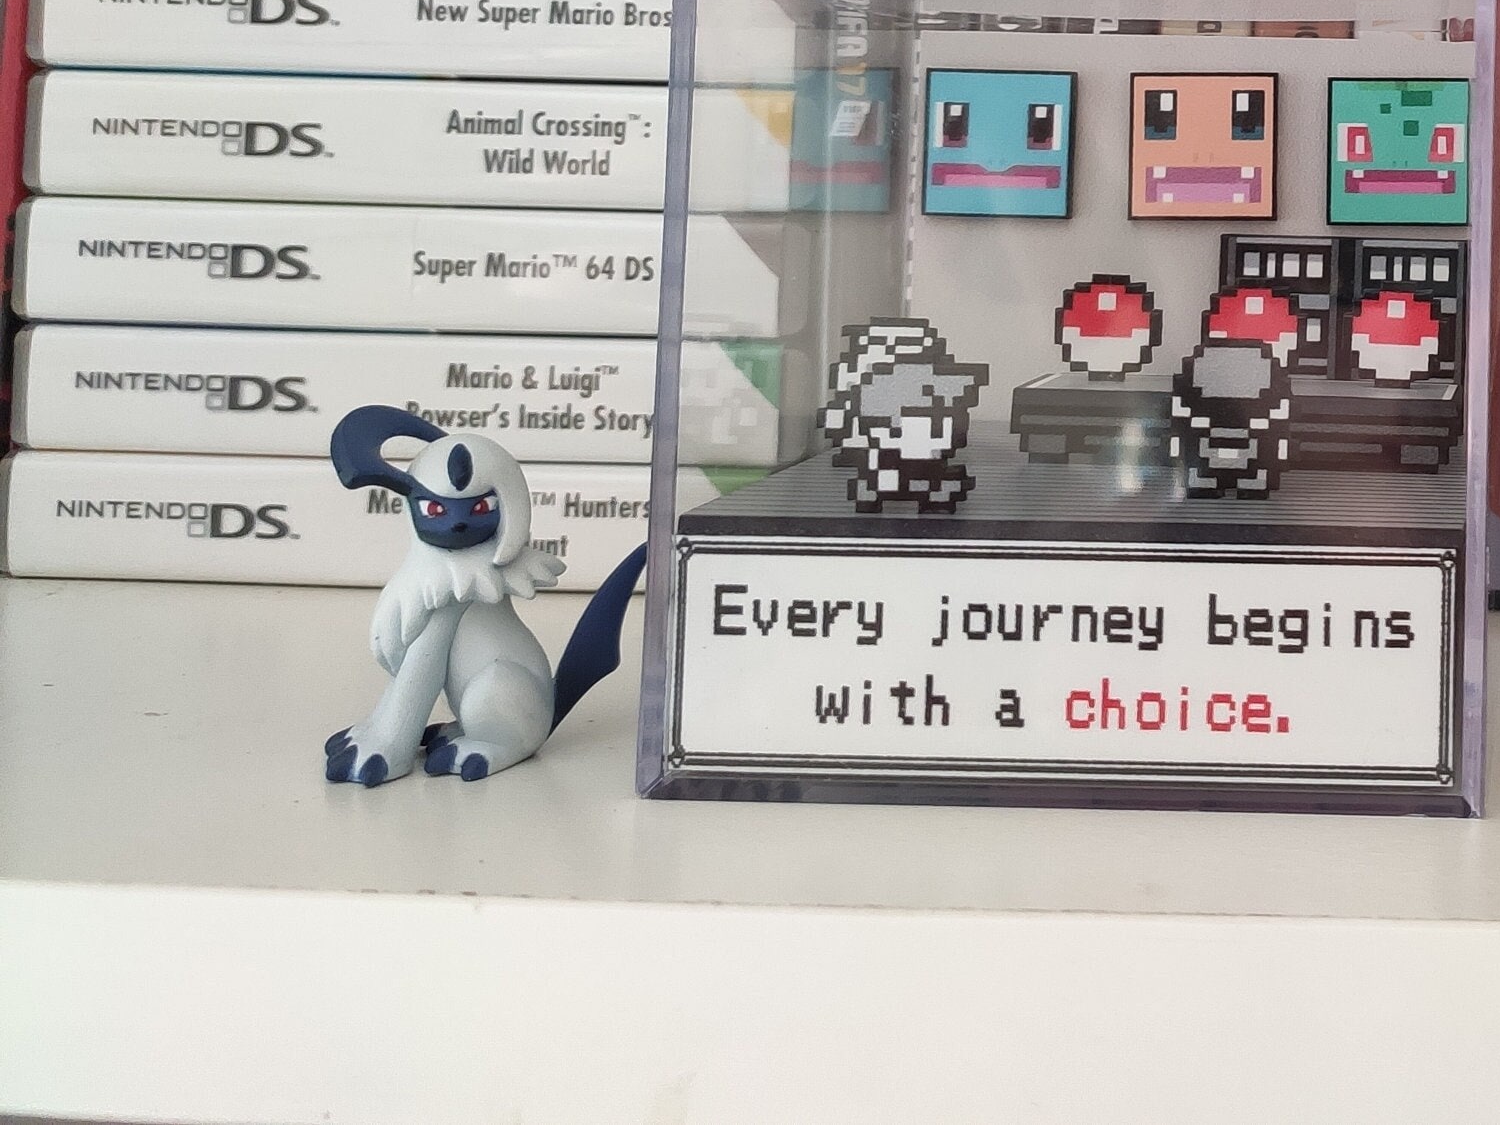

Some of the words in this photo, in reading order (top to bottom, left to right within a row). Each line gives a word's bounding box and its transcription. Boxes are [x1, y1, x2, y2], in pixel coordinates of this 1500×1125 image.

[478, 0, 539, 30] Super
[549, 1, 614, 26] Mario
[92, 117, 242, 137] NINTENDO
[446, 110, 523, 137] Animal
[483, 149, 533, 175] Wild
[542, 150, 610, 177] World
[78, 240, 228, 262] NINTENDO
[414, 253, 477, 283] Super
[585, 256, 616, 280] 64
[624, 257, 654, 282] DS
[75, 371, 226, 393] NINTENDO
[446, 363, 512, 389] Mario
[522, 365, 539, 390] &
[518, 404, 585, 430] Inside
[56, 500, 208, 520] NINTENDO
[713, 584, 882, 646] Every
[931, 594, 1164, 649] journey
[1208, 593, 1416, 653] begins
[816, 675, 950, 727] with
[996, 688, 1024, 729] a
[1065, 678, 1290, 733] choice.
